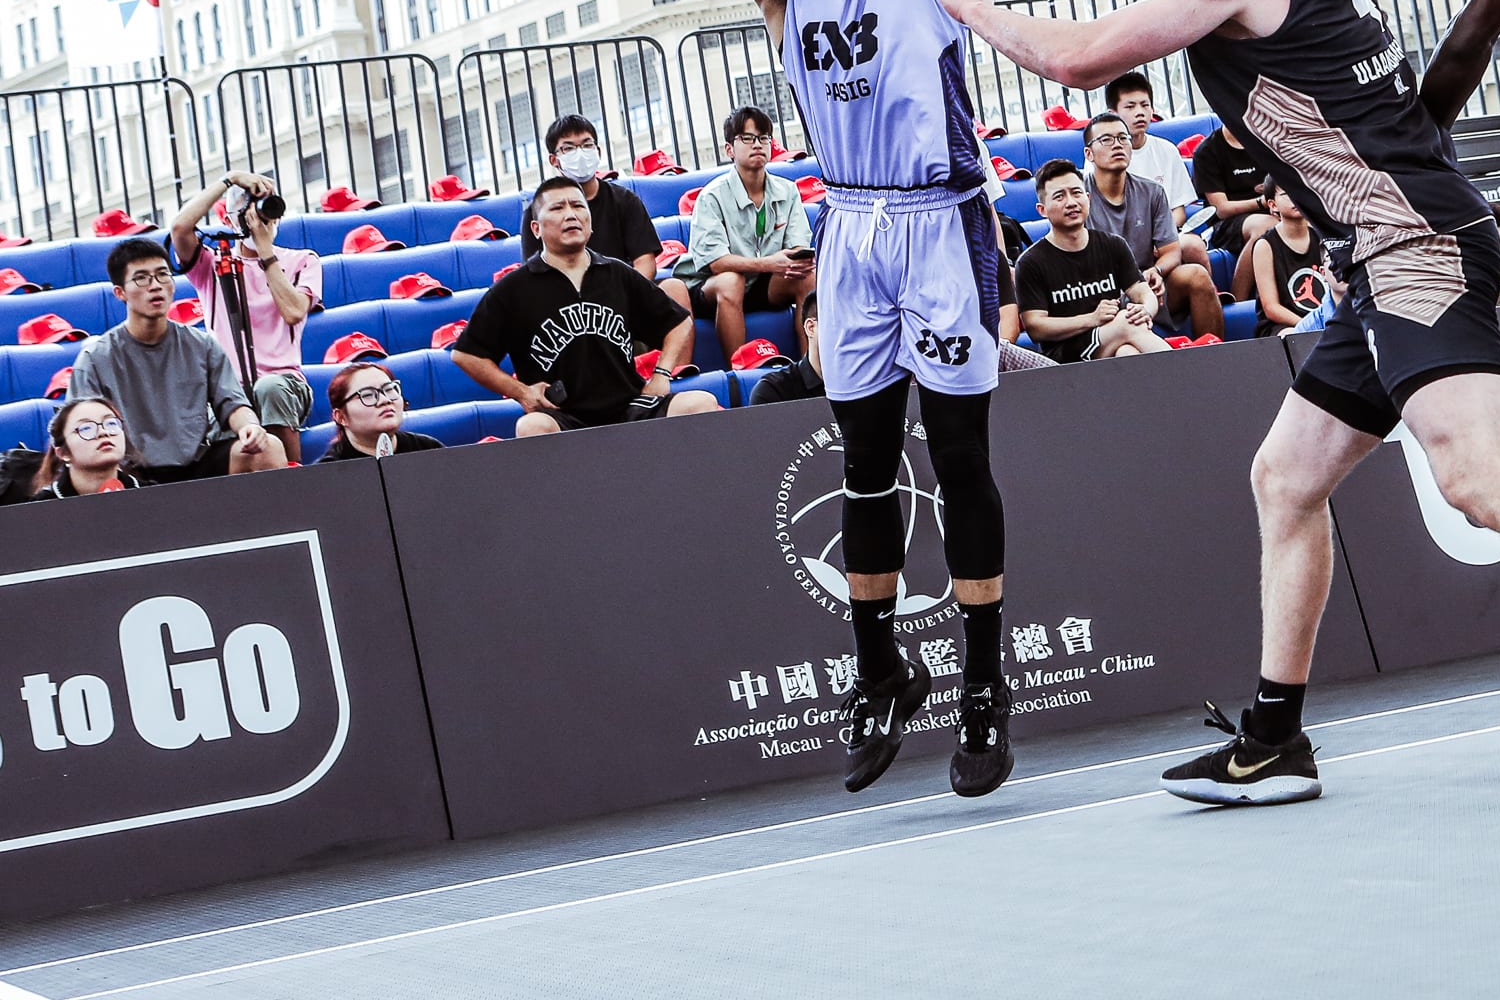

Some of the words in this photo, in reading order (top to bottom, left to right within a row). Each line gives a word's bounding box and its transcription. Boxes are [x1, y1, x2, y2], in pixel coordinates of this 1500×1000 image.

[825, 78, 872, 103] PASIG
[775, 461, 799, 565] ASSOCIAÇÃO
[793, 568, 838, 615] GERAL
[20, 672, 115, 752] to
[118, 595, 301, 750] Go
[693, 714, 799, 746] Associação
[1024, 667, 1086, 690] Macau
[1101, 653, 1156, 675] China
[758, 735, 822, 760] Macau
[1008, 689, 1092, 716] ssociation
